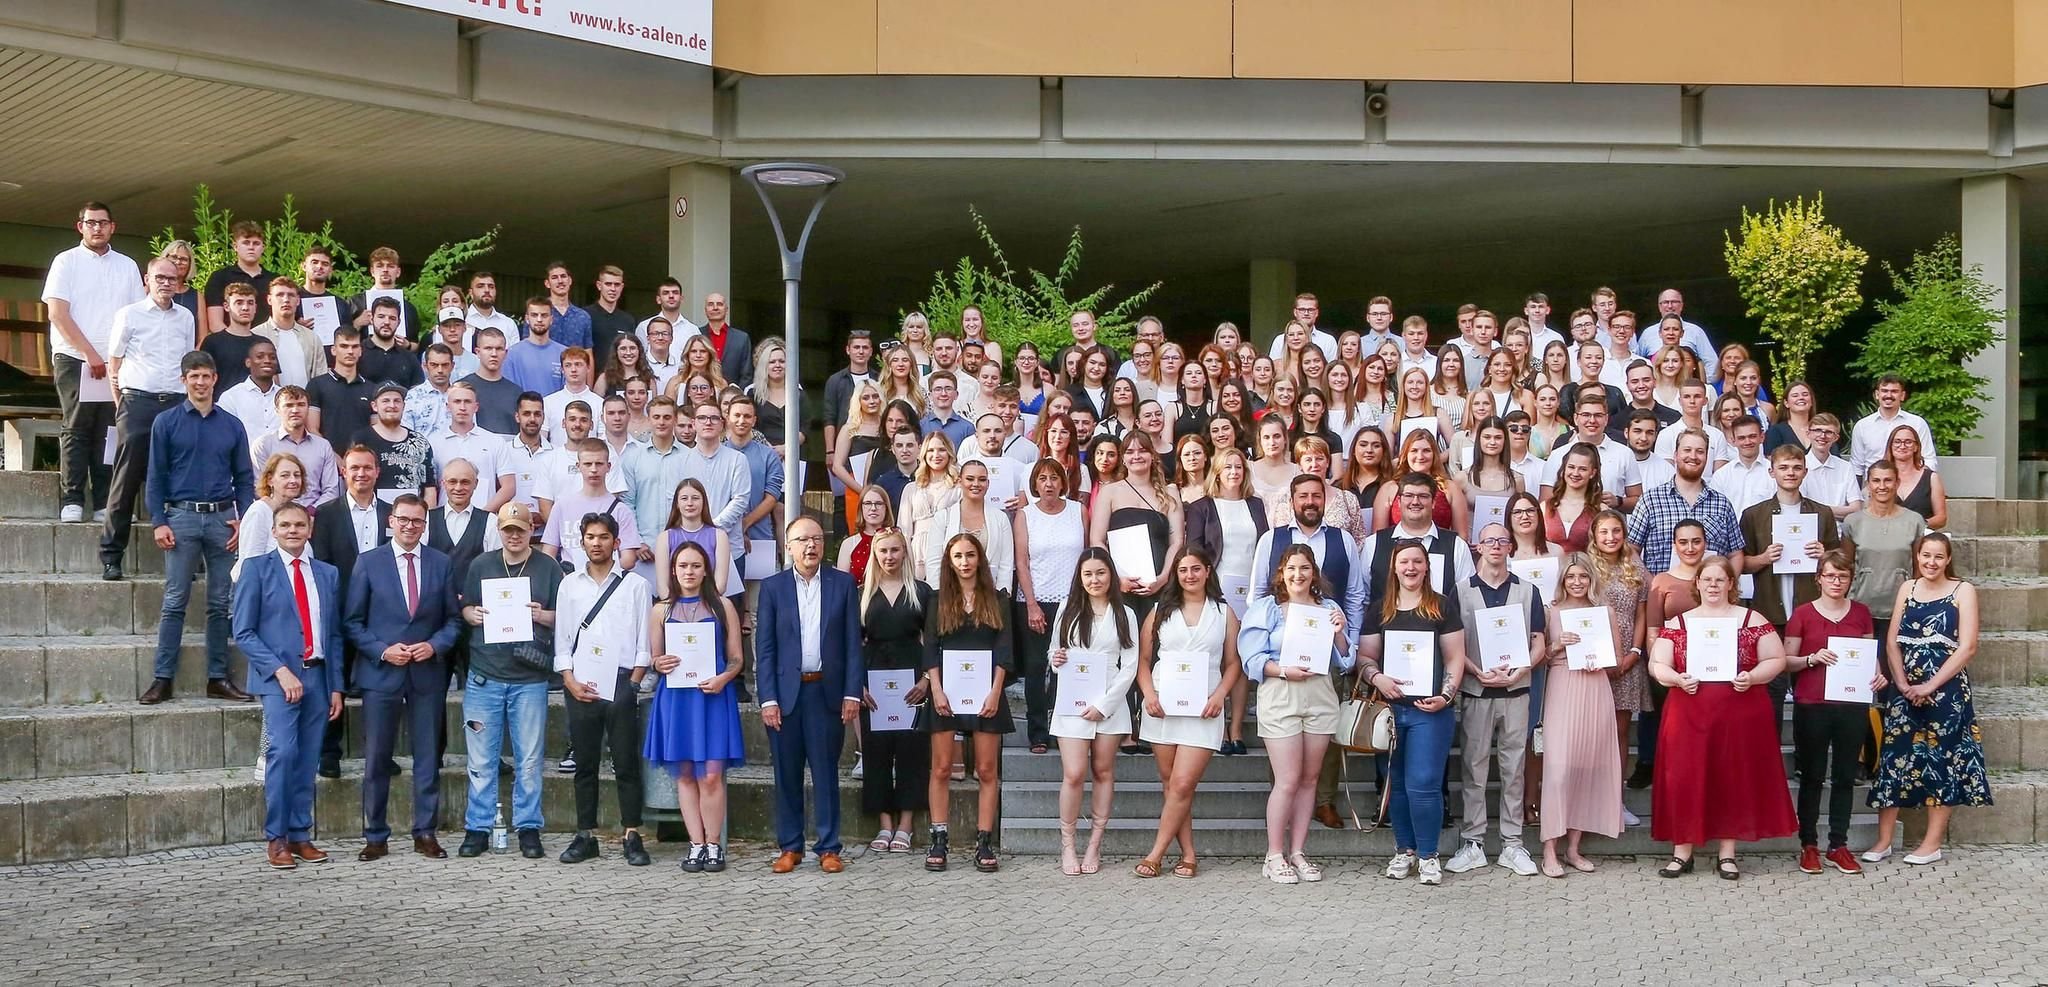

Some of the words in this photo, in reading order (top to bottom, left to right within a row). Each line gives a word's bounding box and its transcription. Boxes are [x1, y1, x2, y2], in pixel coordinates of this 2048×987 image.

[569, 10, 707, 51] www.ks-aalen.de
[685, 671, 698, 679] KSA
[1844, 685, 1856, 693] KSA
[887, 714, 899, 722] KSA
